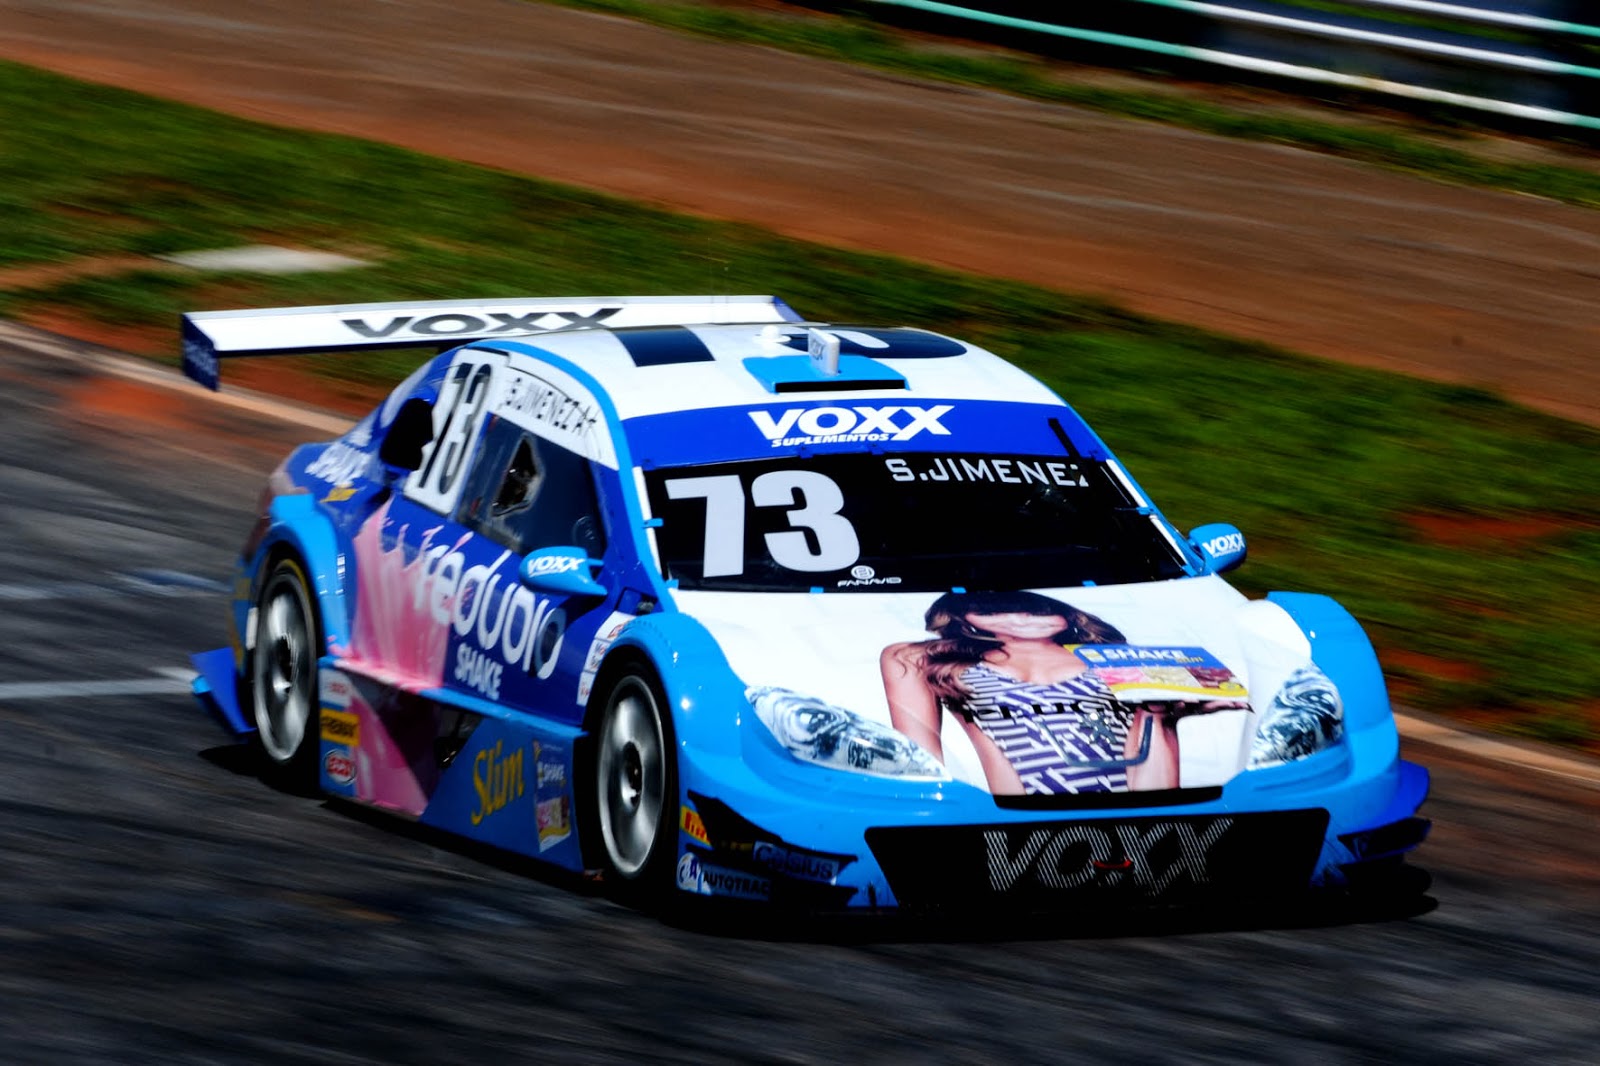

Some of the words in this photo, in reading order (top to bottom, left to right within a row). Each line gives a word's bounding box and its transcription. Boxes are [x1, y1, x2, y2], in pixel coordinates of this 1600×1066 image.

[343, 307, 623, 338] VOXX
[747, 405, 955, 441] VOXX
[771, 433, 889, 448] SUPLEMENTOS
[665, 469, 861, 578] 73
[1202, 532, 1246, 558] VOXX
[527, 555, 586, 577] VOXX
[454, 642, 503, 700] SHAKE
[471, 739, 524, 826] Slim
[984, 818, 1234, 897] VOXX
